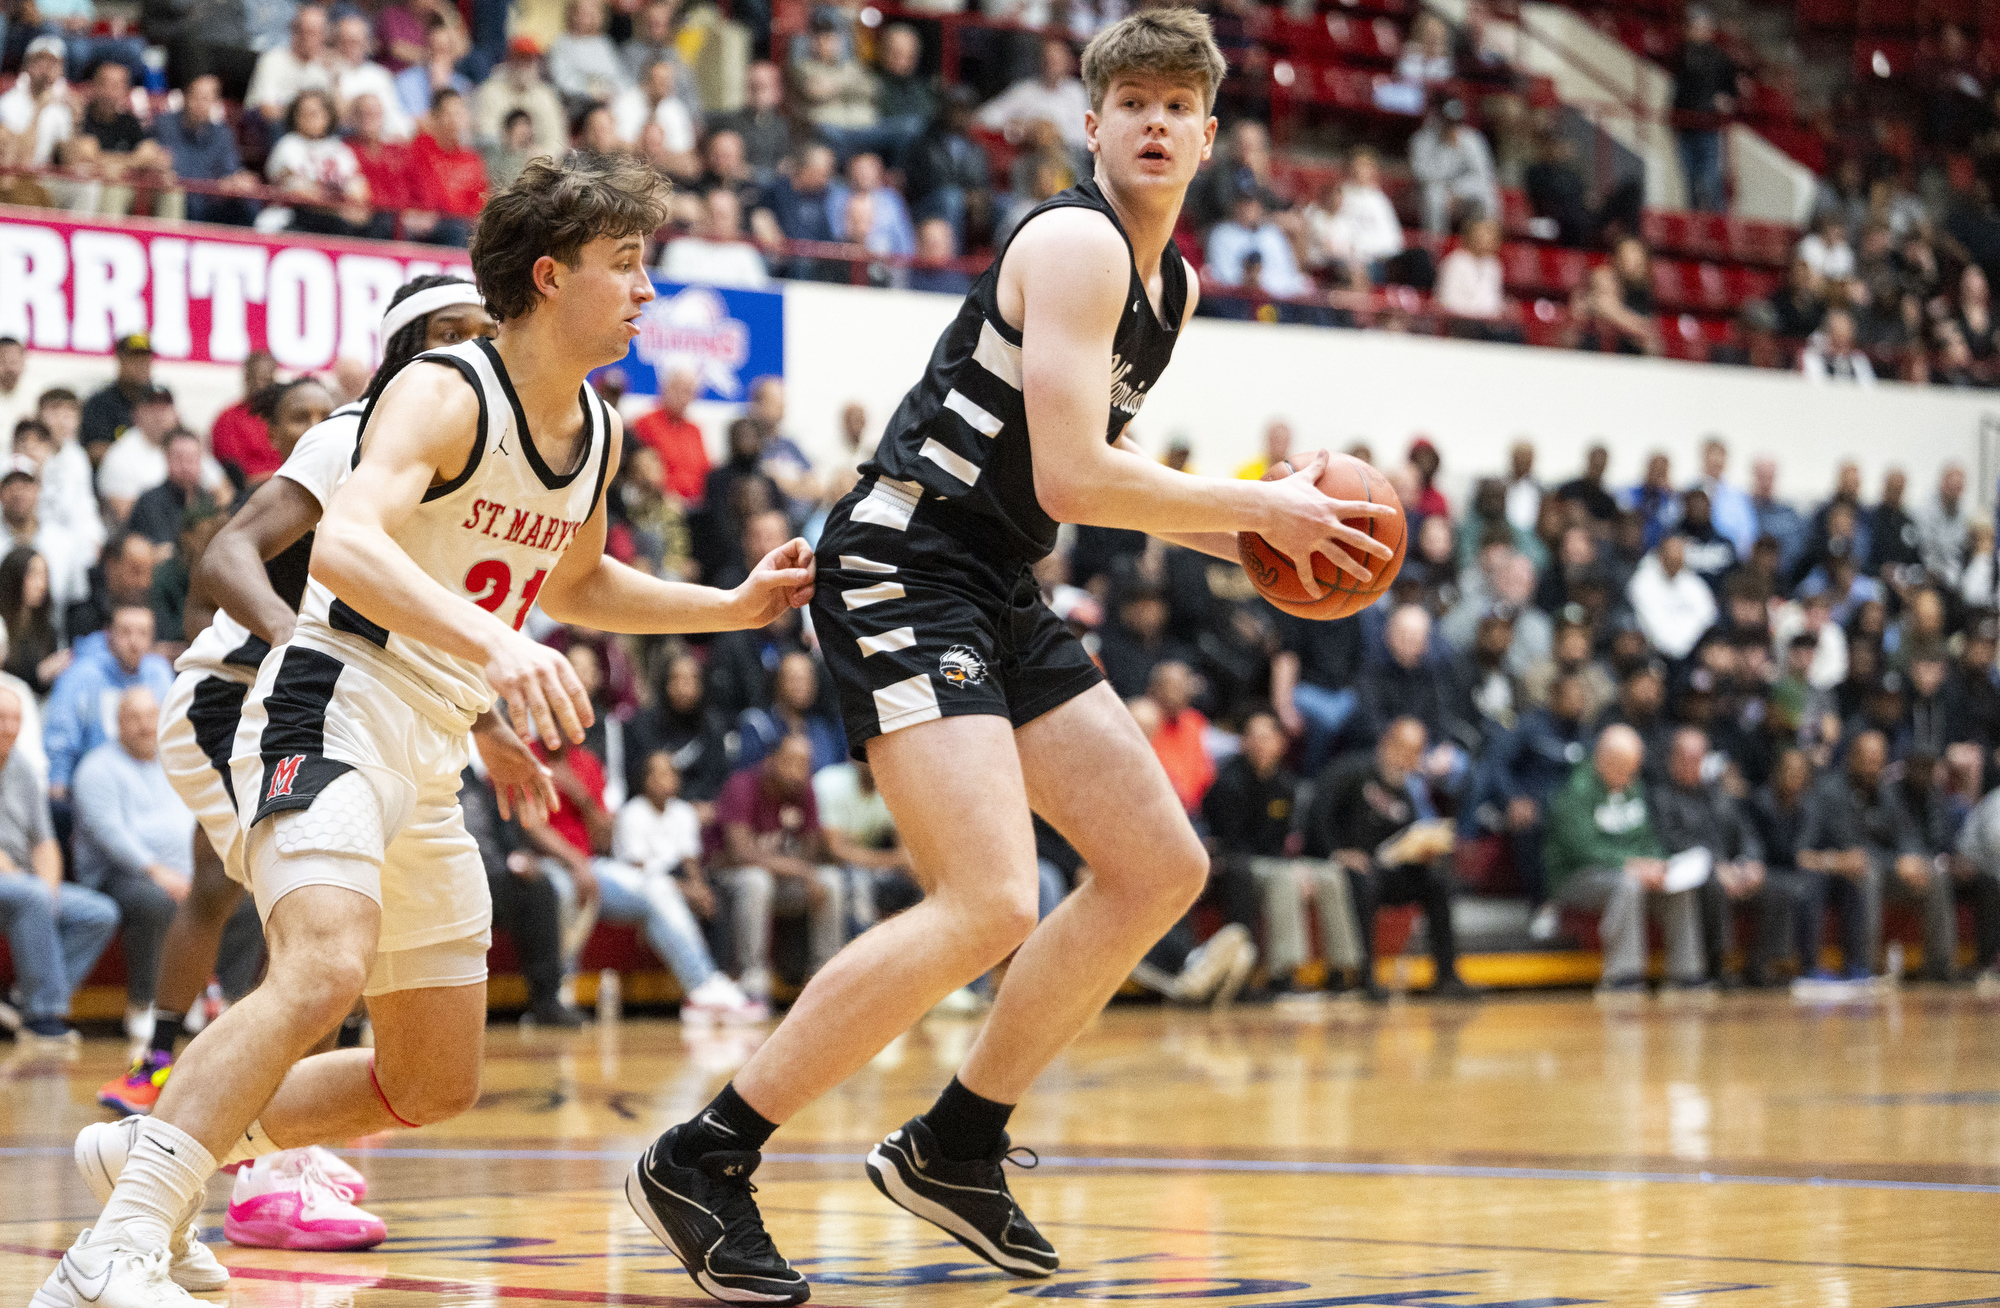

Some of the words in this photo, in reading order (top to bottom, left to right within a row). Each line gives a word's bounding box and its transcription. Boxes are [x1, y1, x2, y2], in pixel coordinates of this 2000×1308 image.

[462, 498, 506, 538] ST.
[463, 558, 549, 632] 21
[266, 754, 306, 801] M
